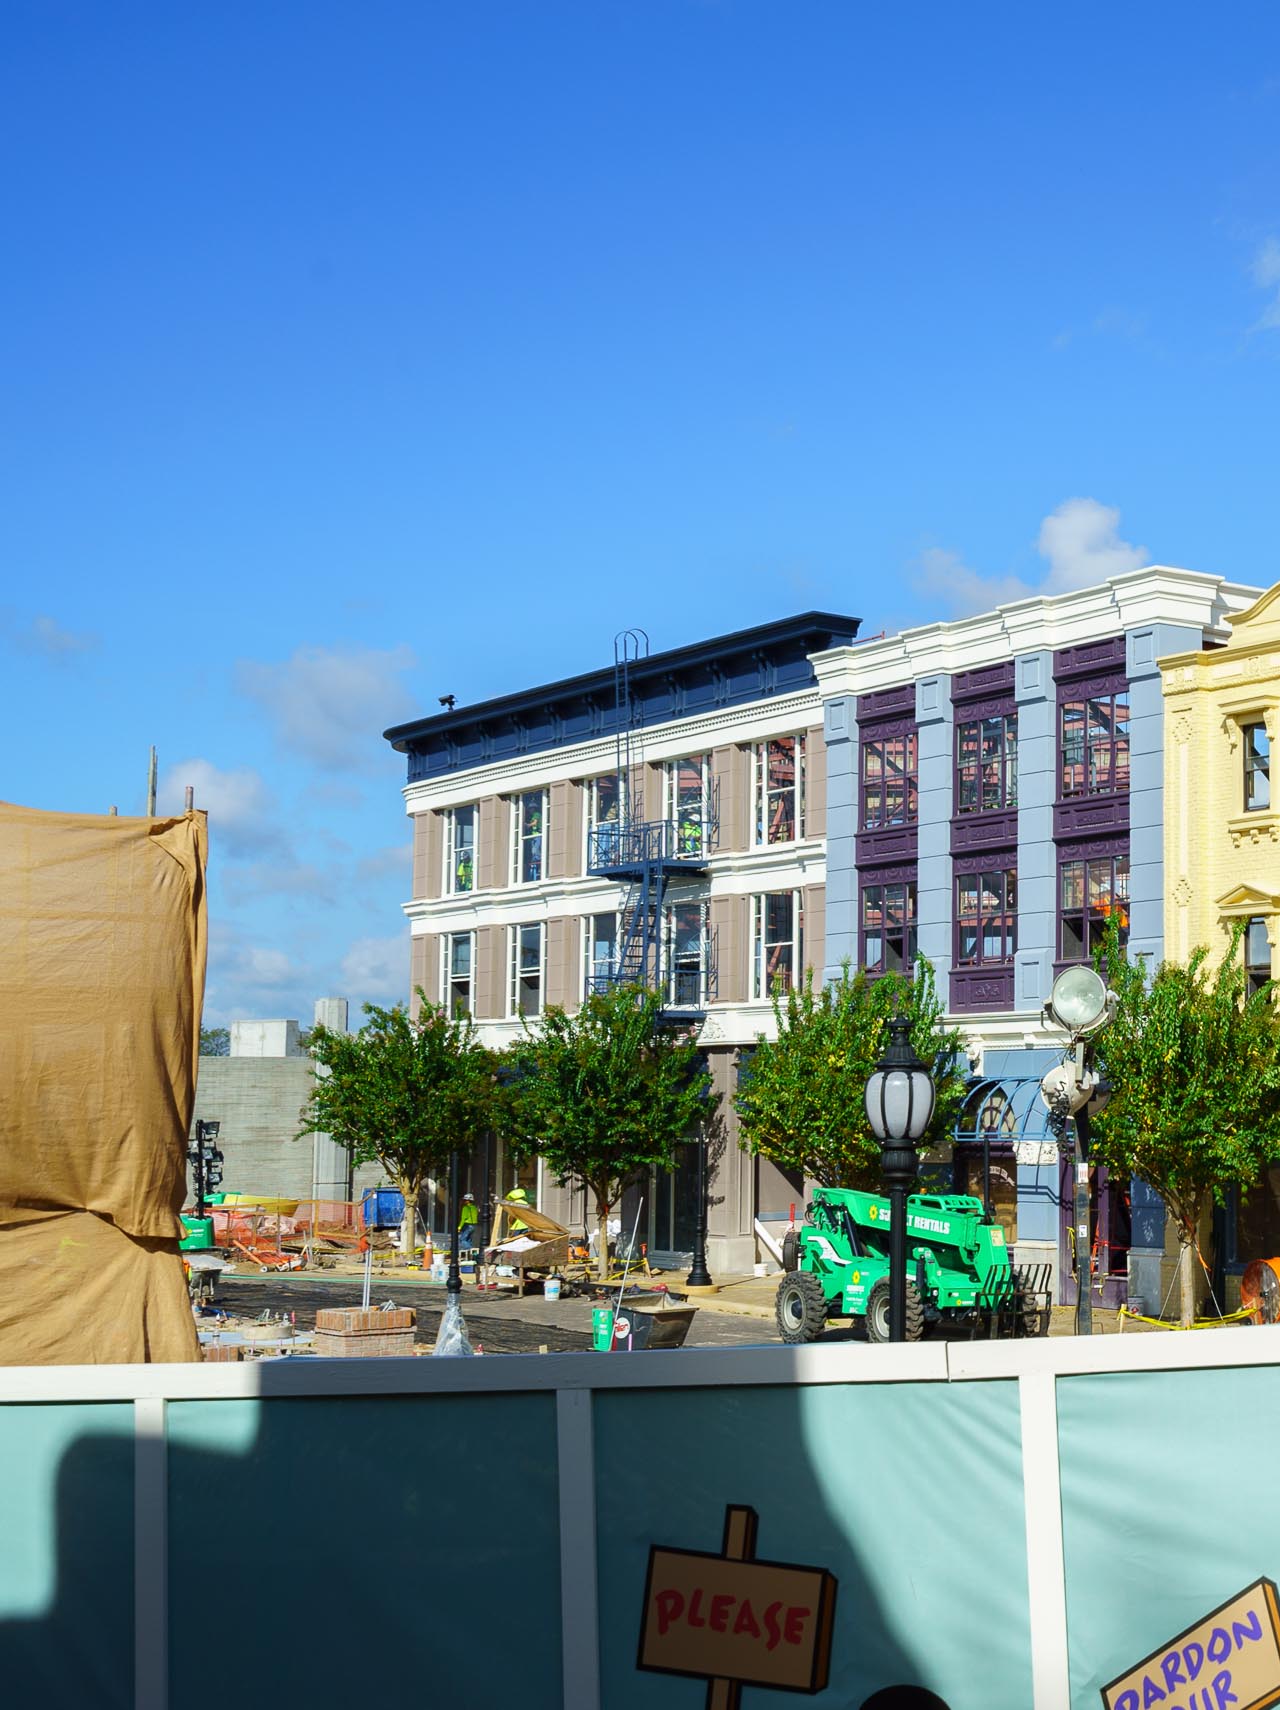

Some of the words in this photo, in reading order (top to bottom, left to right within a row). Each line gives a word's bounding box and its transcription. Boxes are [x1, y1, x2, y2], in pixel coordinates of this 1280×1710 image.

[914, 1216, 950, 1235] RENTALS
[655, 1588, 811, 1651] PLEASE
[1114, 1610, 1263, 1710] PARDON
